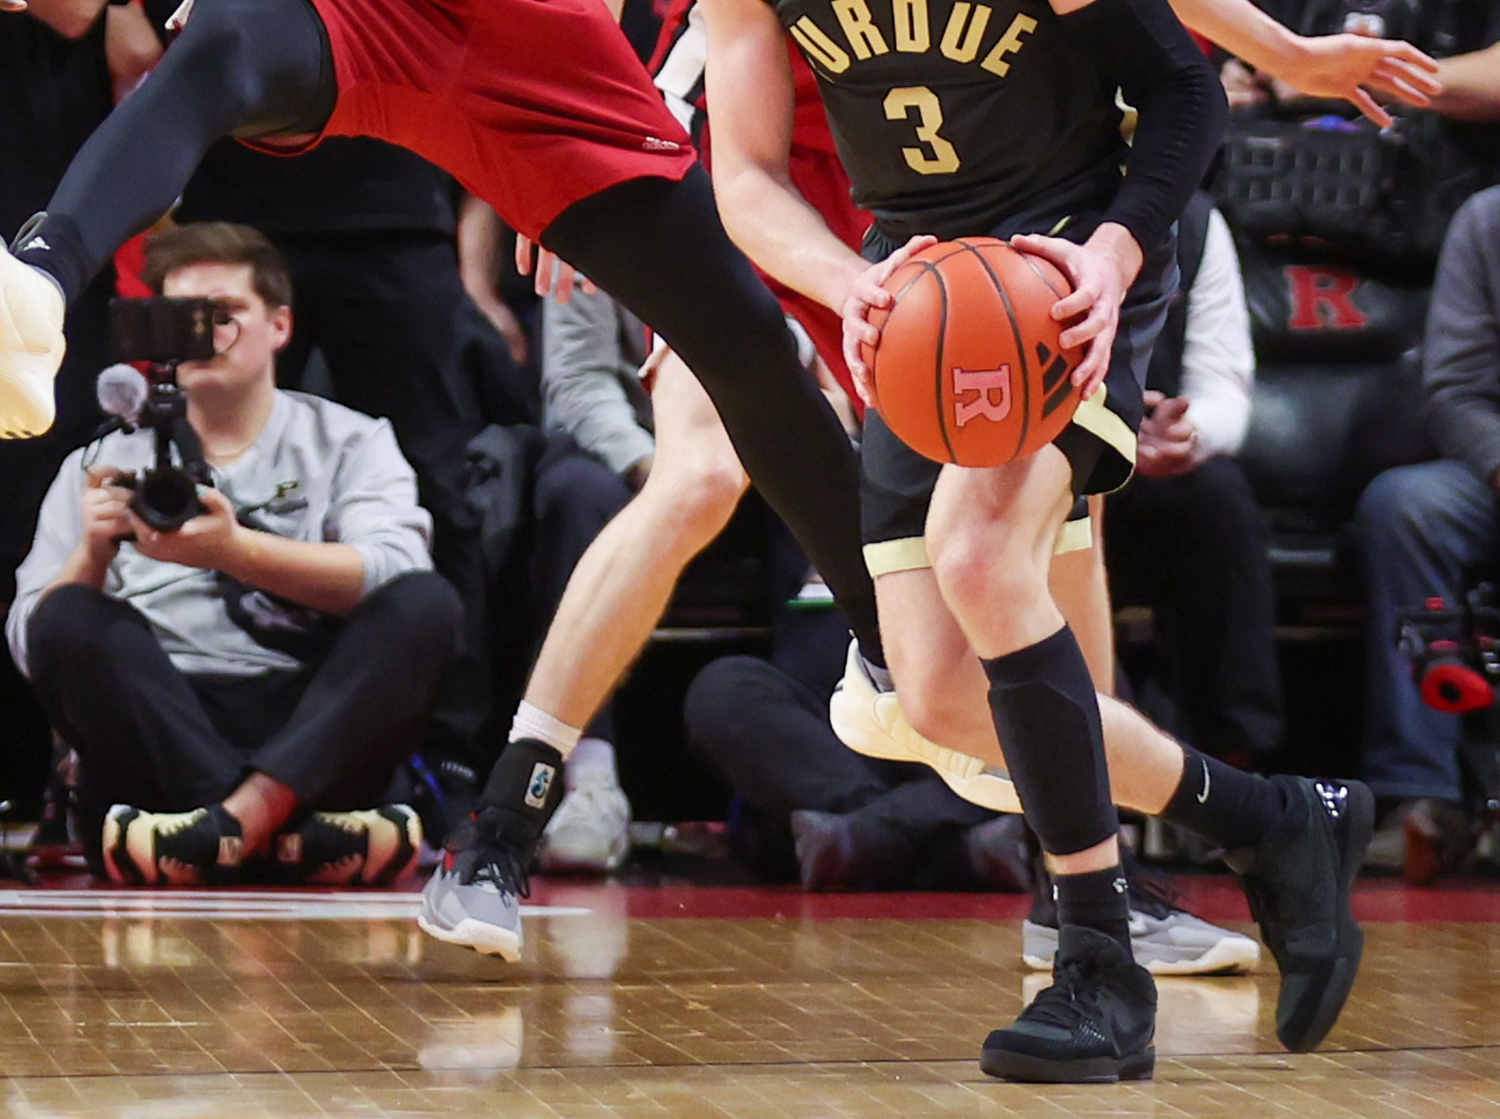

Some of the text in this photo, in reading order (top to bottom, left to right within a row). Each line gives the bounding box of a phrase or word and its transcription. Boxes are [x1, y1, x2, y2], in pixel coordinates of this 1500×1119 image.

[882, 85, 962, 175] 3
[1282, 265, 1368, 331] R
[952, 363, 1012, 428] R
